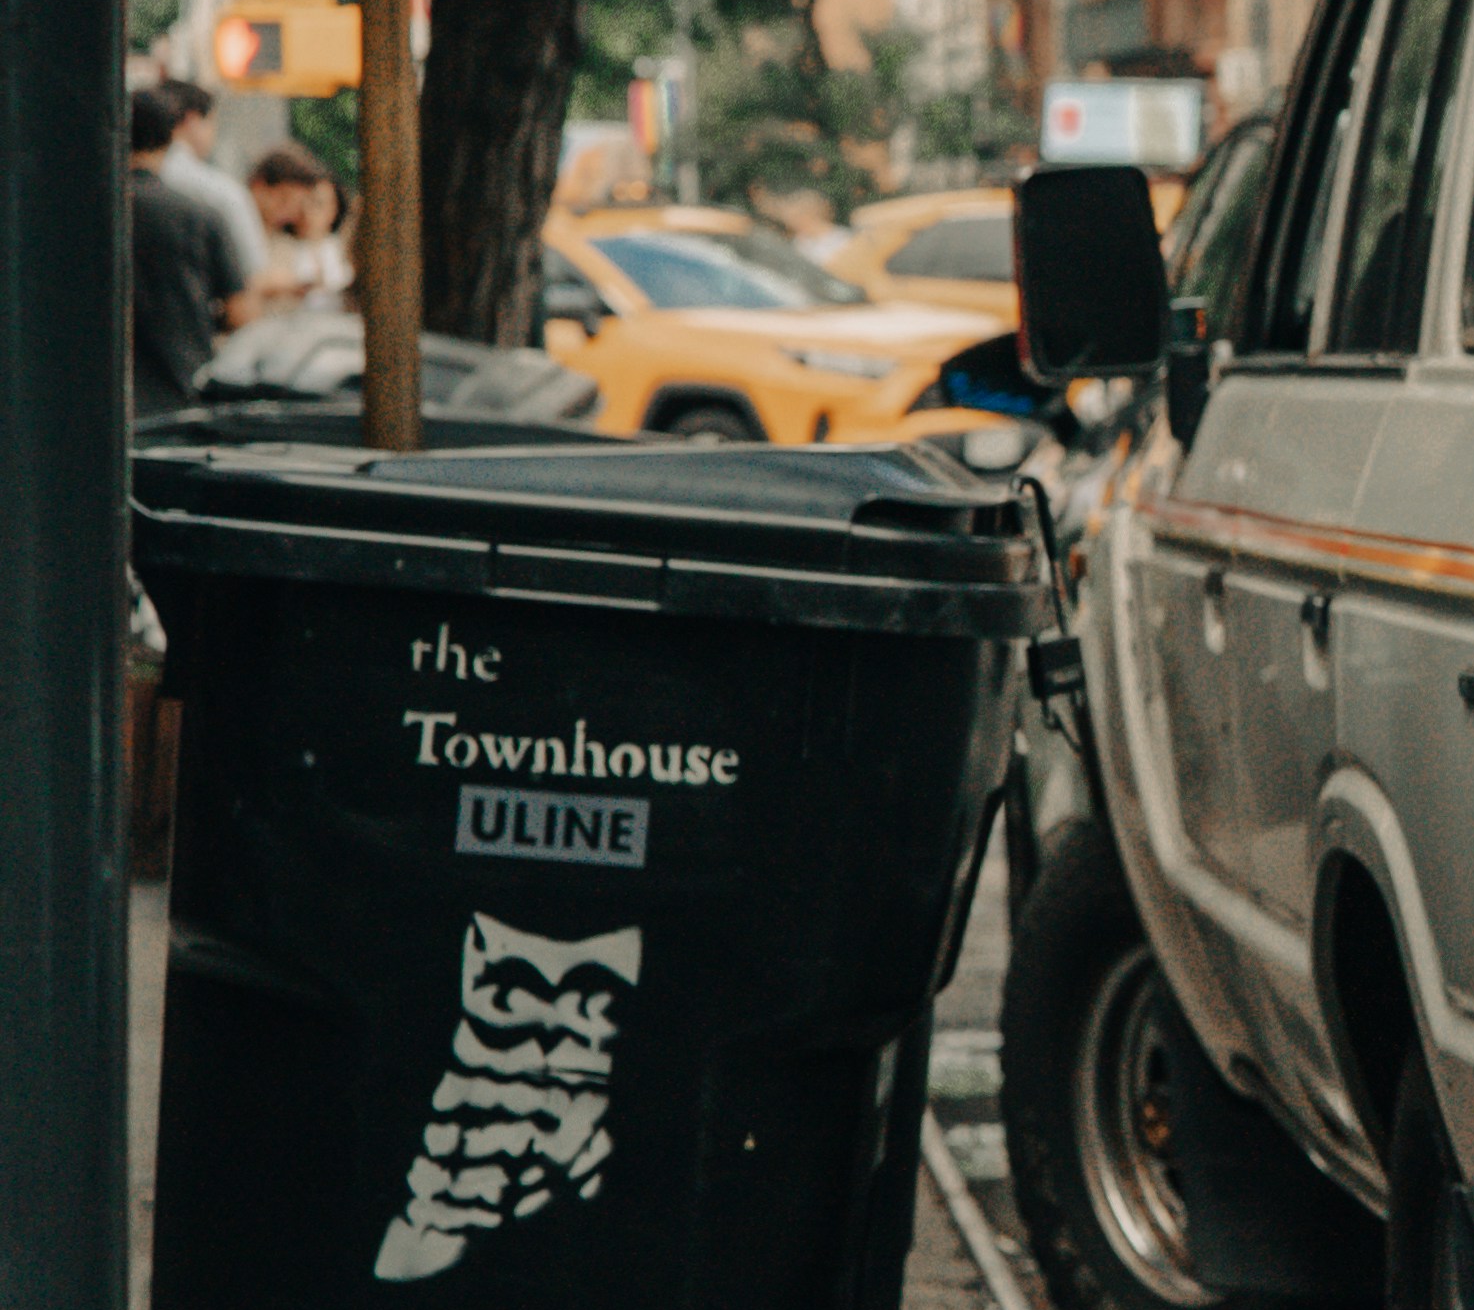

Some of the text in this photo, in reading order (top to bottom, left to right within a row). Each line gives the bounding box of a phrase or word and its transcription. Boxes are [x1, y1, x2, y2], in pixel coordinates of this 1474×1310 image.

[410, 622, 502, 684] the
[403, 710, 740, 785] Townhouse
[469, 796, 637, 854] ULINE
